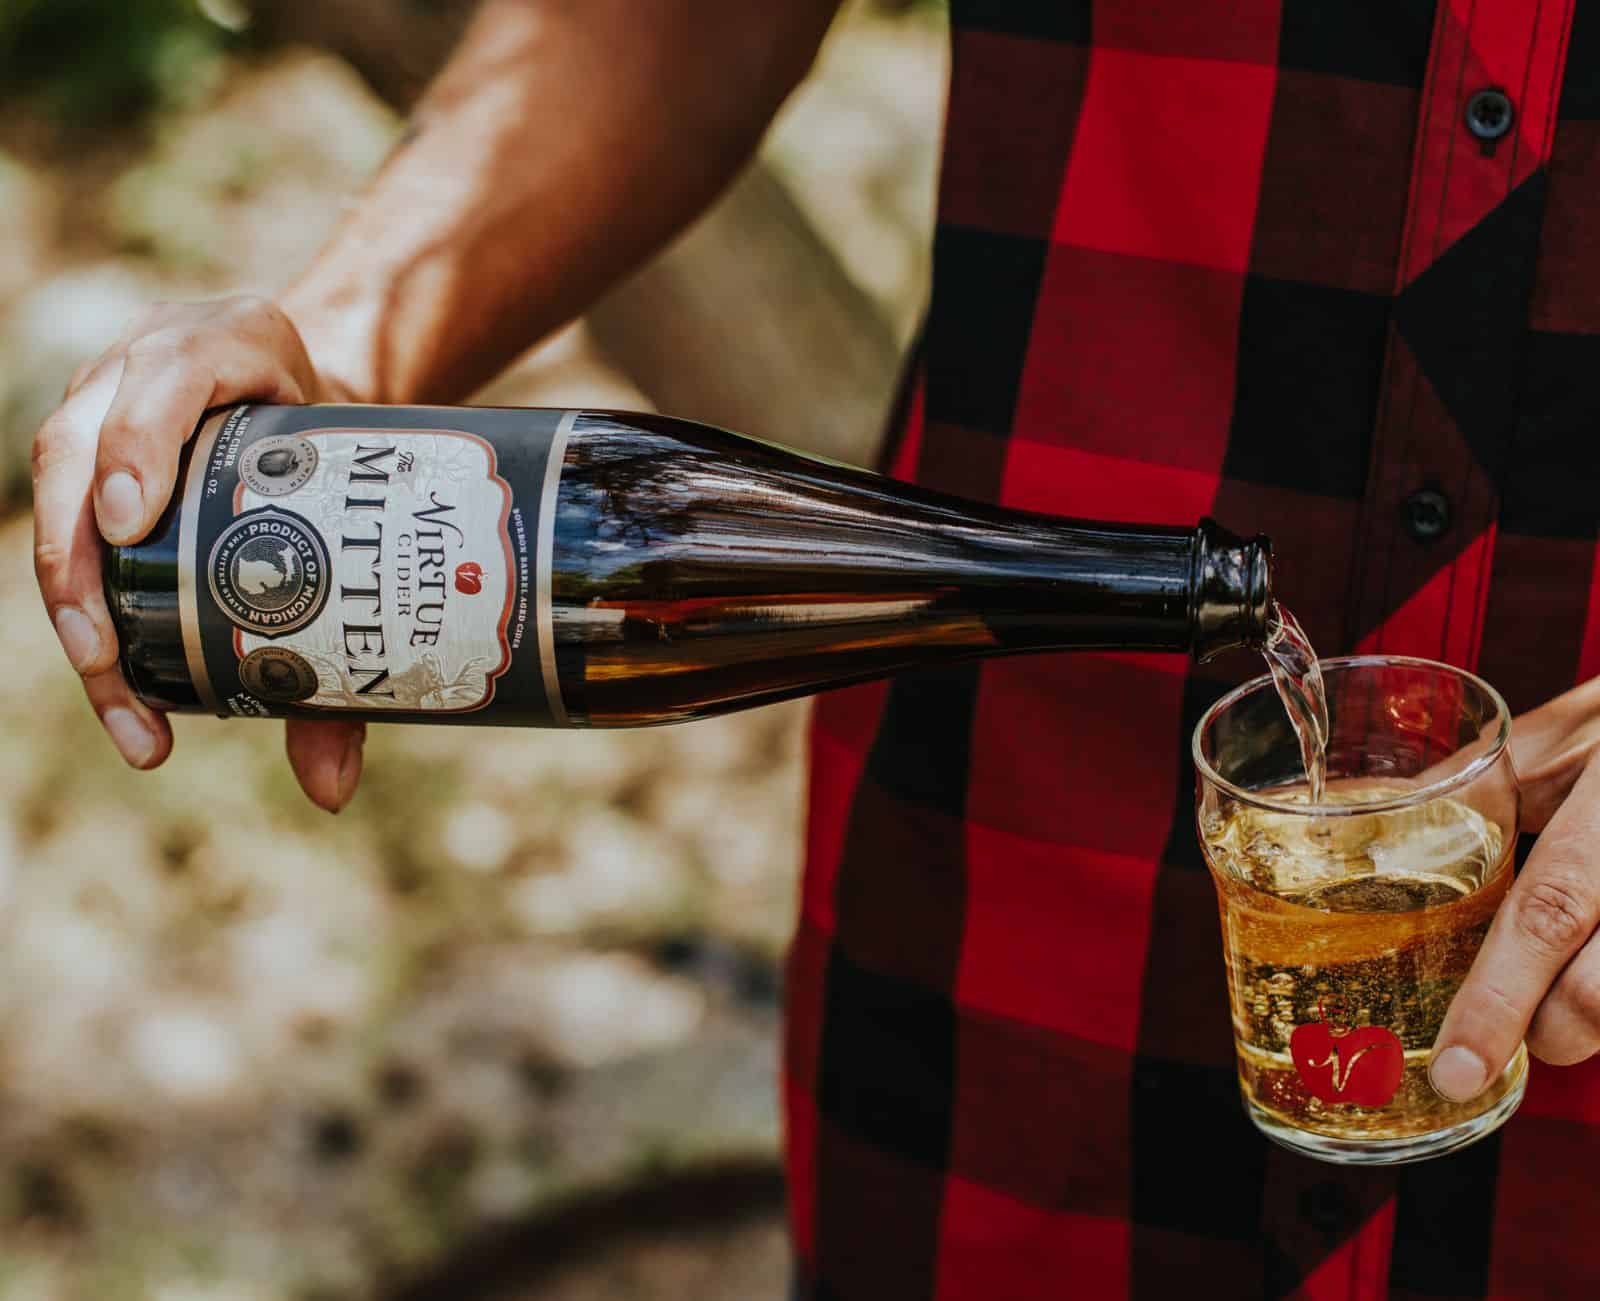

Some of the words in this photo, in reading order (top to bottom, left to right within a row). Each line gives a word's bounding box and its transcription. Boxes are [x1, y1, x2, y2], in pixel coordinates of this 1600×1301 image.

[224, 439, 240, 466] CIDER
[396, 450, 414, 473] The
[227, 532, 244, 548] THE
[248, 522, 313, 557] PRODUCT
[512, 508, 527, 553] BOURBON
[218, 550, 230, 585] MITTEN
[305, 561, 317, 582] OF
[341, 445, 396, 699] MITTEN
[397, 533, 411, 617] CIDER
[410, 490, 464, 647] VIRTUE
[520, 556, 528, 594] BARREL
[222, 587, 244, 612] STATE
[248, 585, 315, 624] MICHIGAN
[518, 595, 527, 622] AGED
[512, 623, 524, 648] CIDER
